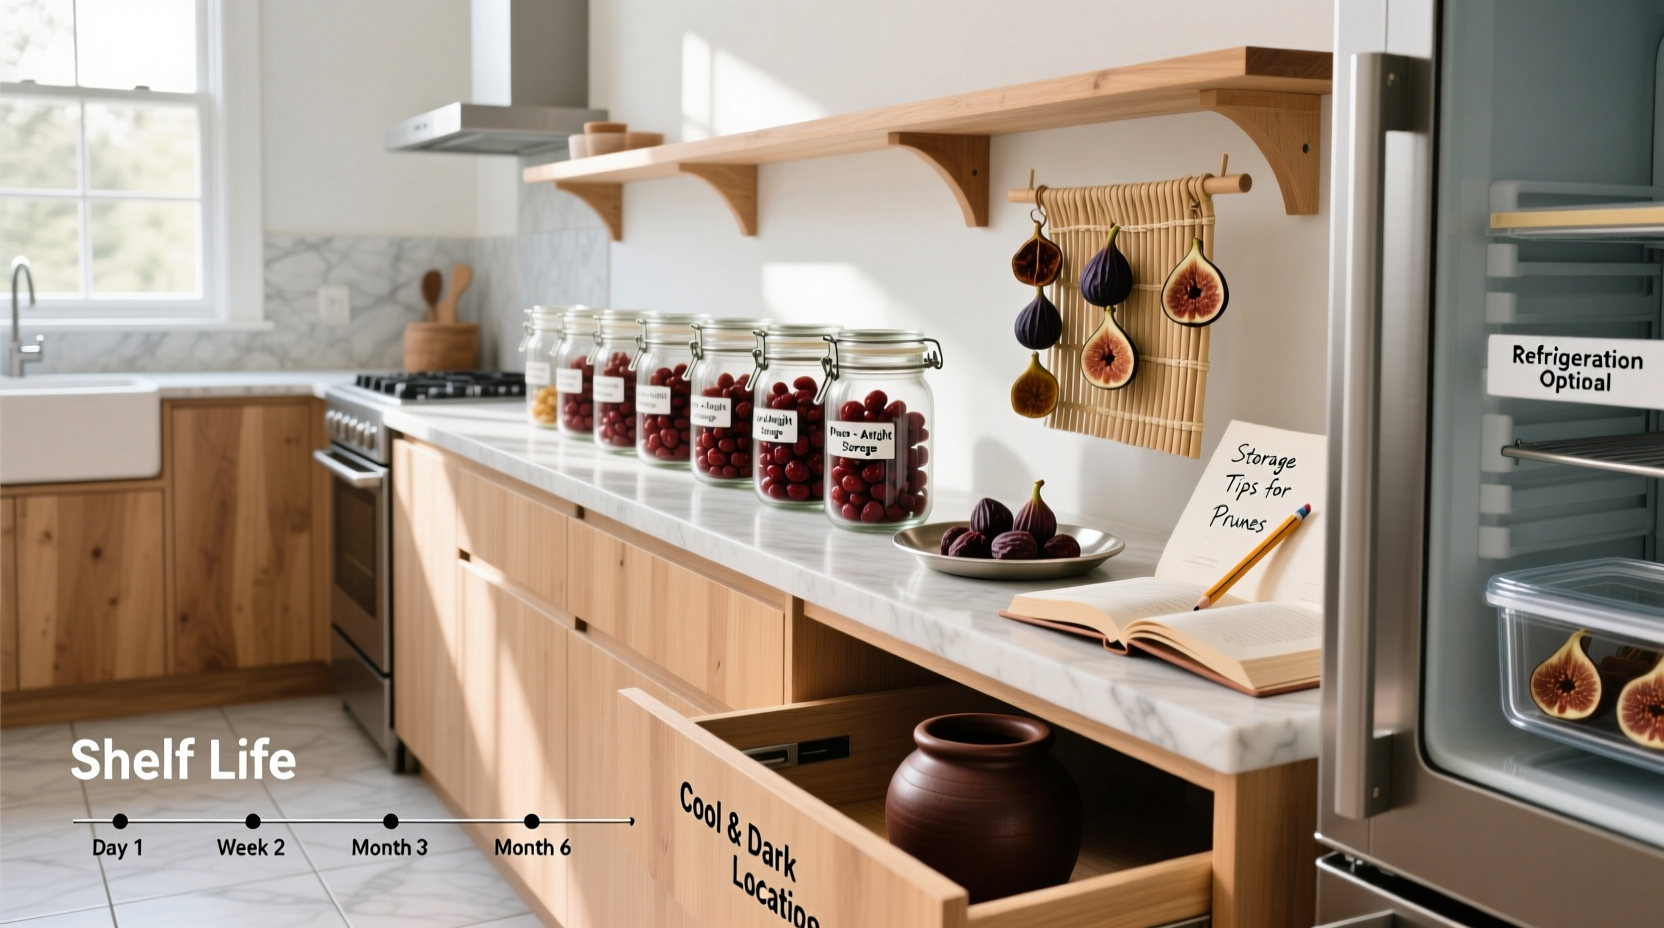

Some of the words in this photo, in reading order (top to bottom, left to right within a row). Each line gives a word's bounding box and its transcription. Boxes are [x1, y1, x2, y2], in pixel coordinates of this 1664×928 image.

[1513, 345, 1643, 371] Refrigeration
[1231, 443, 1297, 475] Storage
[1226, 474, 1258, 501] Tips
[1265, 477, 1292, 498] for
[1209, 504, 1267, 533] Prunes
[680, 781, 722, 834] Cool
[727, 811, 742, 847] &
[748, 822, 797, 883] Dark
